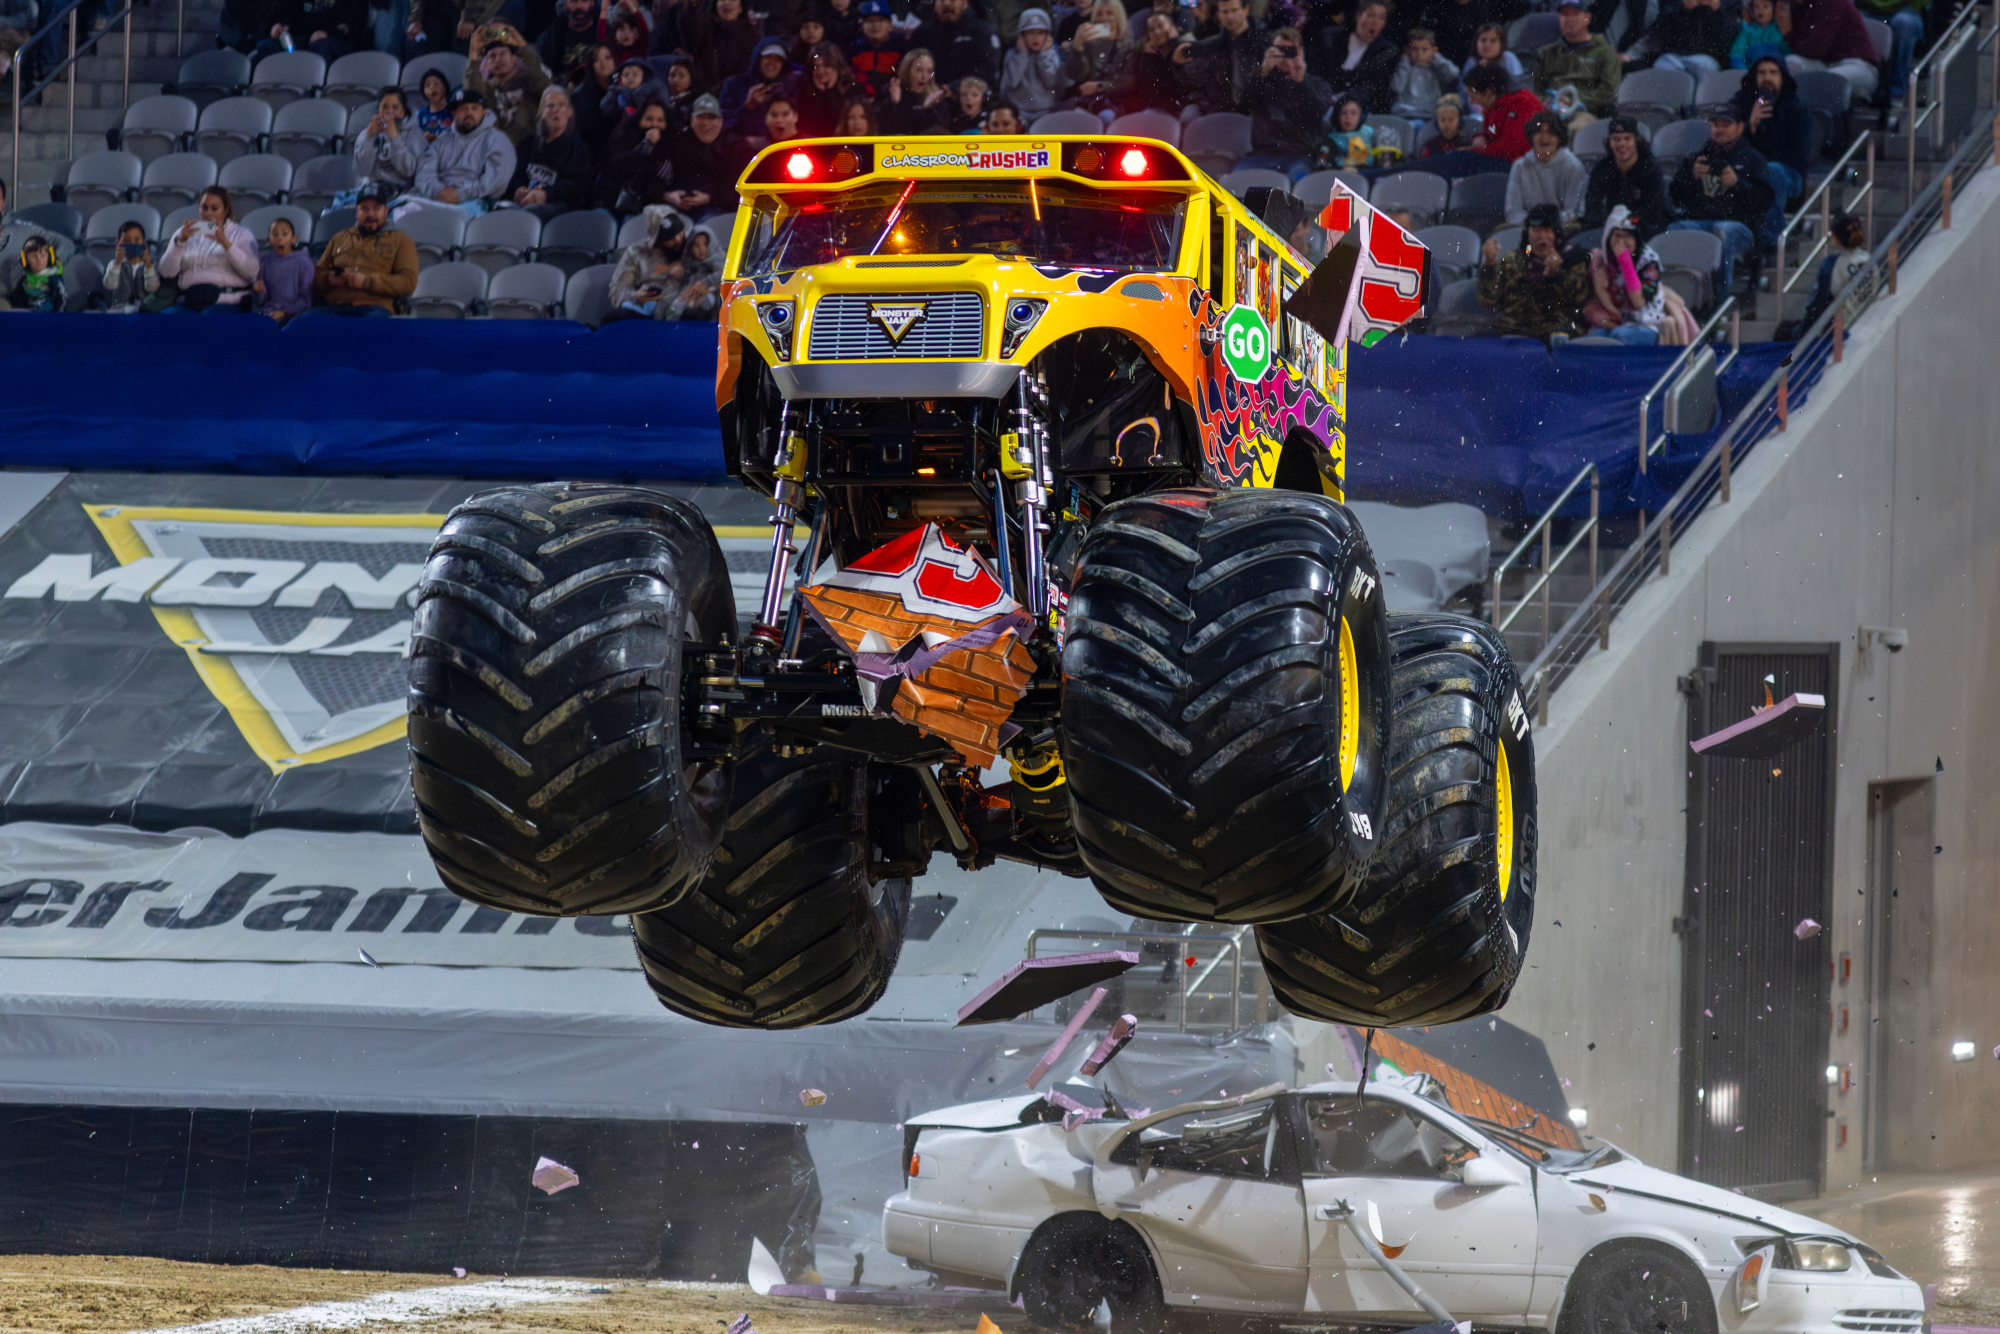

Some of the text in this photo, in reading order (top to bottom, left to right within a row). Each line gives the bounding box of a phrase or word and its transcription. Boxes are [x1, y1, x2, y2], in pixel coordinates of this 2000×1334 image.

[882, 150, 1051, 170] CLASSROOM CRUSHER
[871, 309, 924, 318] MONSTER
[885, 317, 909, 325] JAM
[1228, 323, 1266, 362] GO
[3, 553, 422, 610] MON
[1350, 565, 1376, 600] BKT
[199, 617, 414, 659] JA
[1508, 687, 1530, 742] BKT
[1520, 812, 1537, 901] BKT
